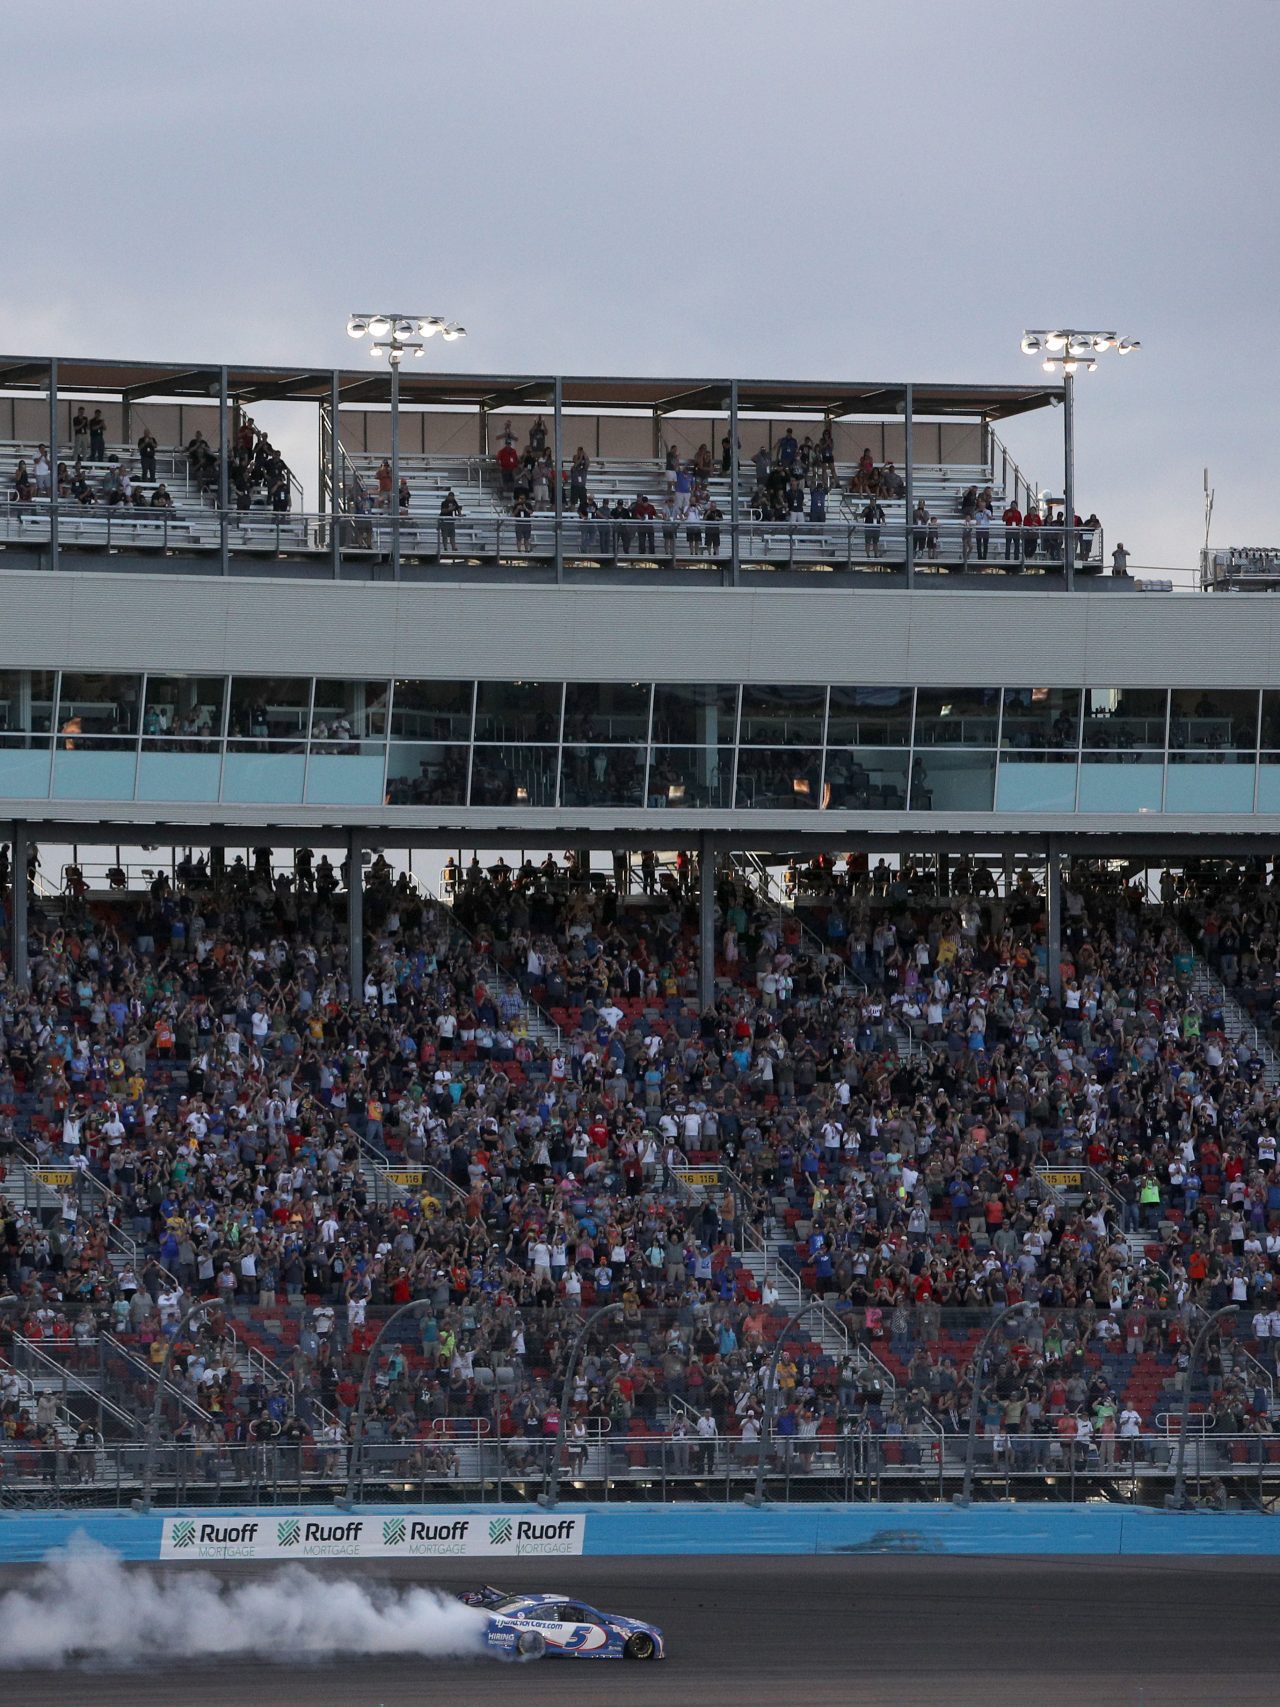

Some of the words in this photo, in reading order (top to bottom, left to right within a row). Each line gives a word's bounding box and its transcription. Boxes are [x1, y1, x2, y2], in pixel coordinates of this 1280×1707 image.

[56, 1175, 68, 1183] 117
[405, 1175, 419, 1183] 116
[700, 1175, 714, 1183] 115
[1064, 1175, 1077, 1183] 114
[200, 1524, 258, 1542] Ruoff
[305, 1522, 363, 1541] Ruoff
[411, 1521, 469, 1540] Ruoff
[517, 1520, 575, 1539] Ruoff
[199, 1547, 255, 1557] MORTGAGE
[304, 1545, 360, 1555] MORTGAGE
[409, 1543, 466, 1554] MORTGAGE
[516, 1543, 572, 1553] MORTGAGE
[488, 1632, 514, 1641] HIRING
[563, 1626, 593, 1649] 5
